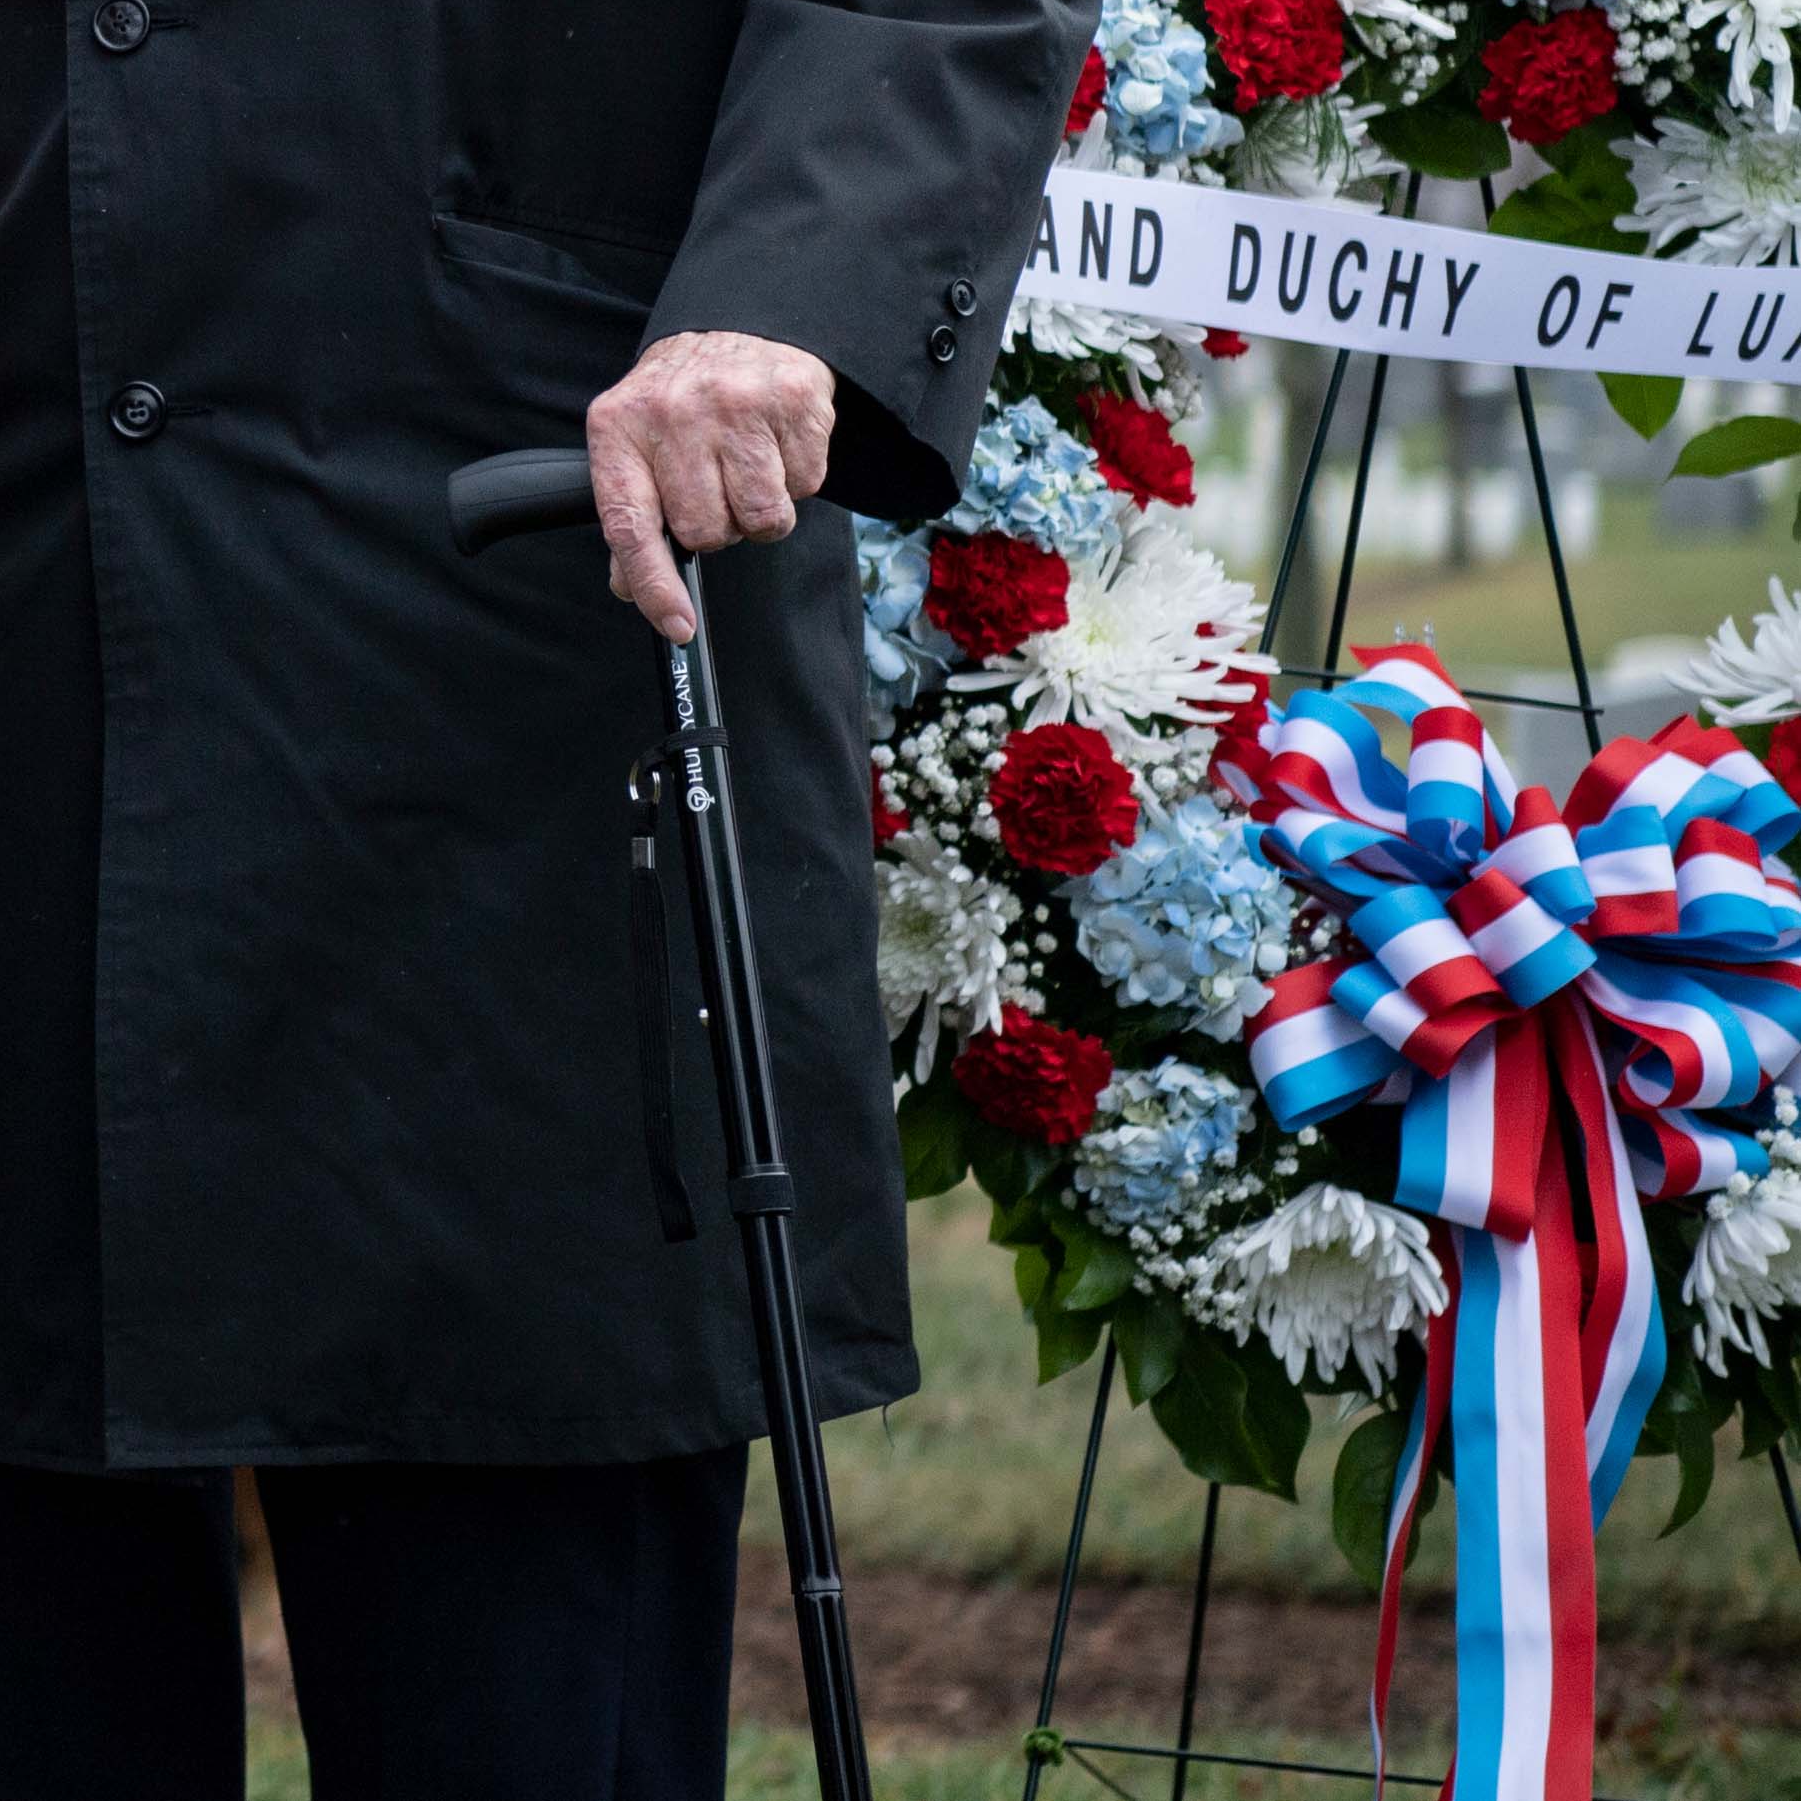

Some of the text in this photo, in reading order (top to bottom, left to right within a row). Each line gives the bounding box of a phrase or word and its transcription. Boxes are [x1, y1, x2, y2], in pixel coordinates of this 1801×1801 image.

[1025, 194, 1801, 363] AND DUCHY OF LU
[671, 660, 705, 784] HUYCANE
